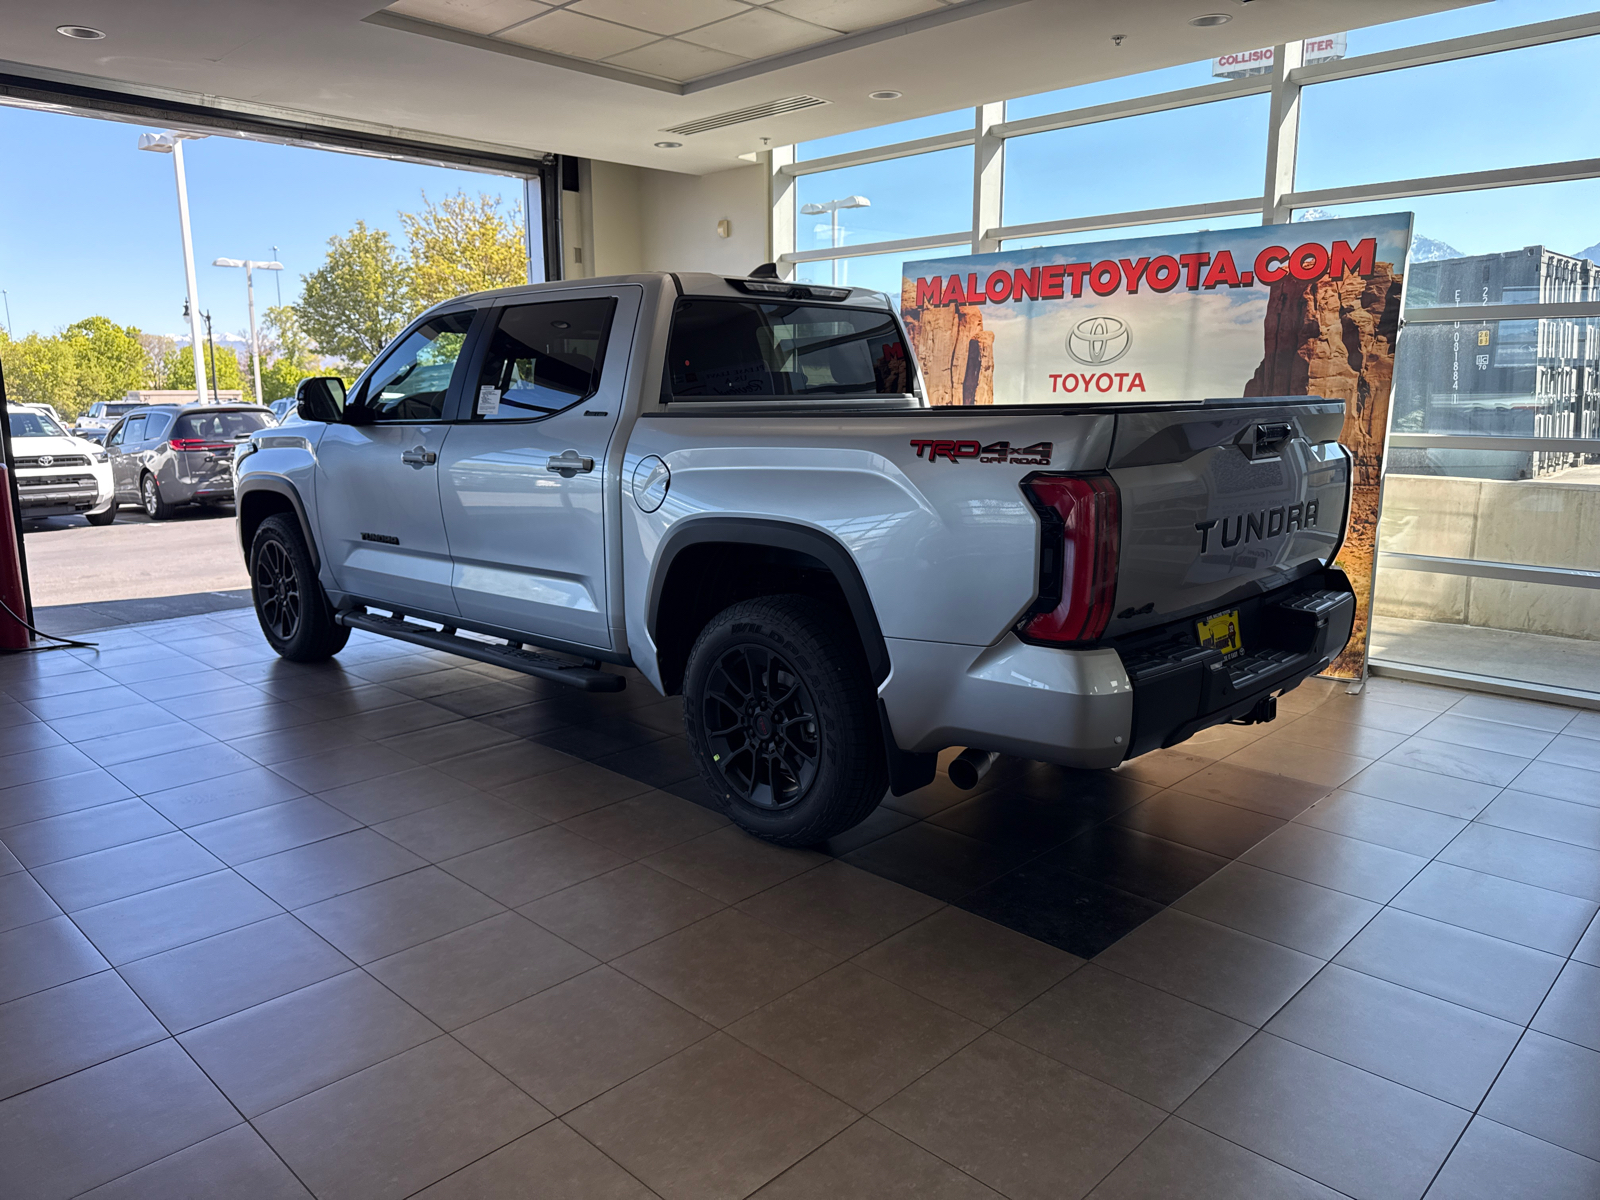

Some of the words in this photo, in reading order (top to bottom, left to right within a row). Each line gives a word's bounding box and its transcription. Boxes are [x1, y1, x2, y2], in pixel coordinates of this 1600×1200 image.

[1218, 49, 1273, 66] COLLISIO
[1306, 39, 1333, 53] TER
[915, 237, 1377, 308] MALONETOYOTA.COM
[1048, 372, 1147, 393] TOYOTA
[909, 440, 982, 464] TRD
[1009, 457, 1051, 466] ROAD
[360, 532, 400, 545] TUNDRA
[1194, 498, 1319, 556] TUNDRA
[731, 622, 829, 709] WILDPEAK
